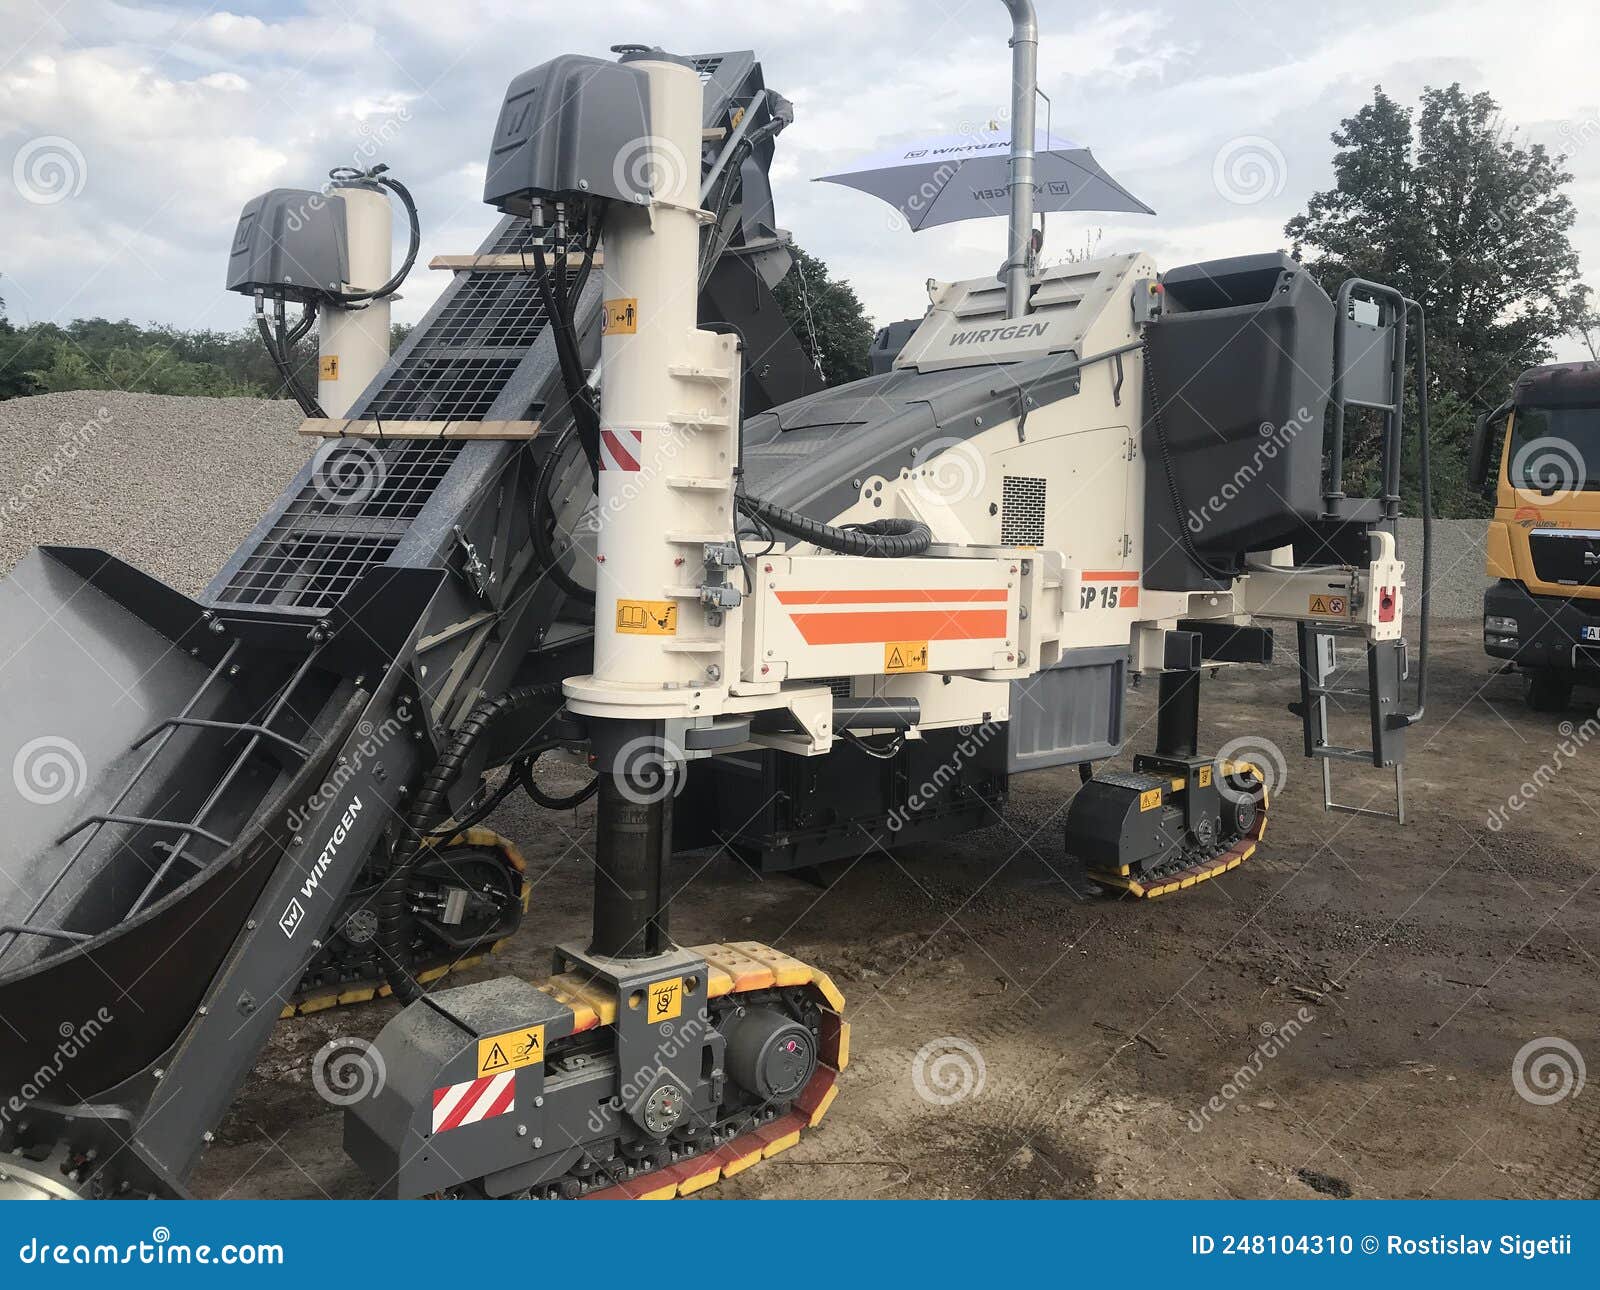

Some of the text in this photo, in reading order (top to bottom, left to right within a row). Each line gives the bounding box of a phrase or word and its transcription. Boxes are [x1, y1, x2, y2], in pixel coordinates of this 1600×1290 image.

[949, 322, 1050, 346] WIRTGEN
[1100, 587, 1118, 608] 15
[300, 795, 363, 898] WIRTGEN
